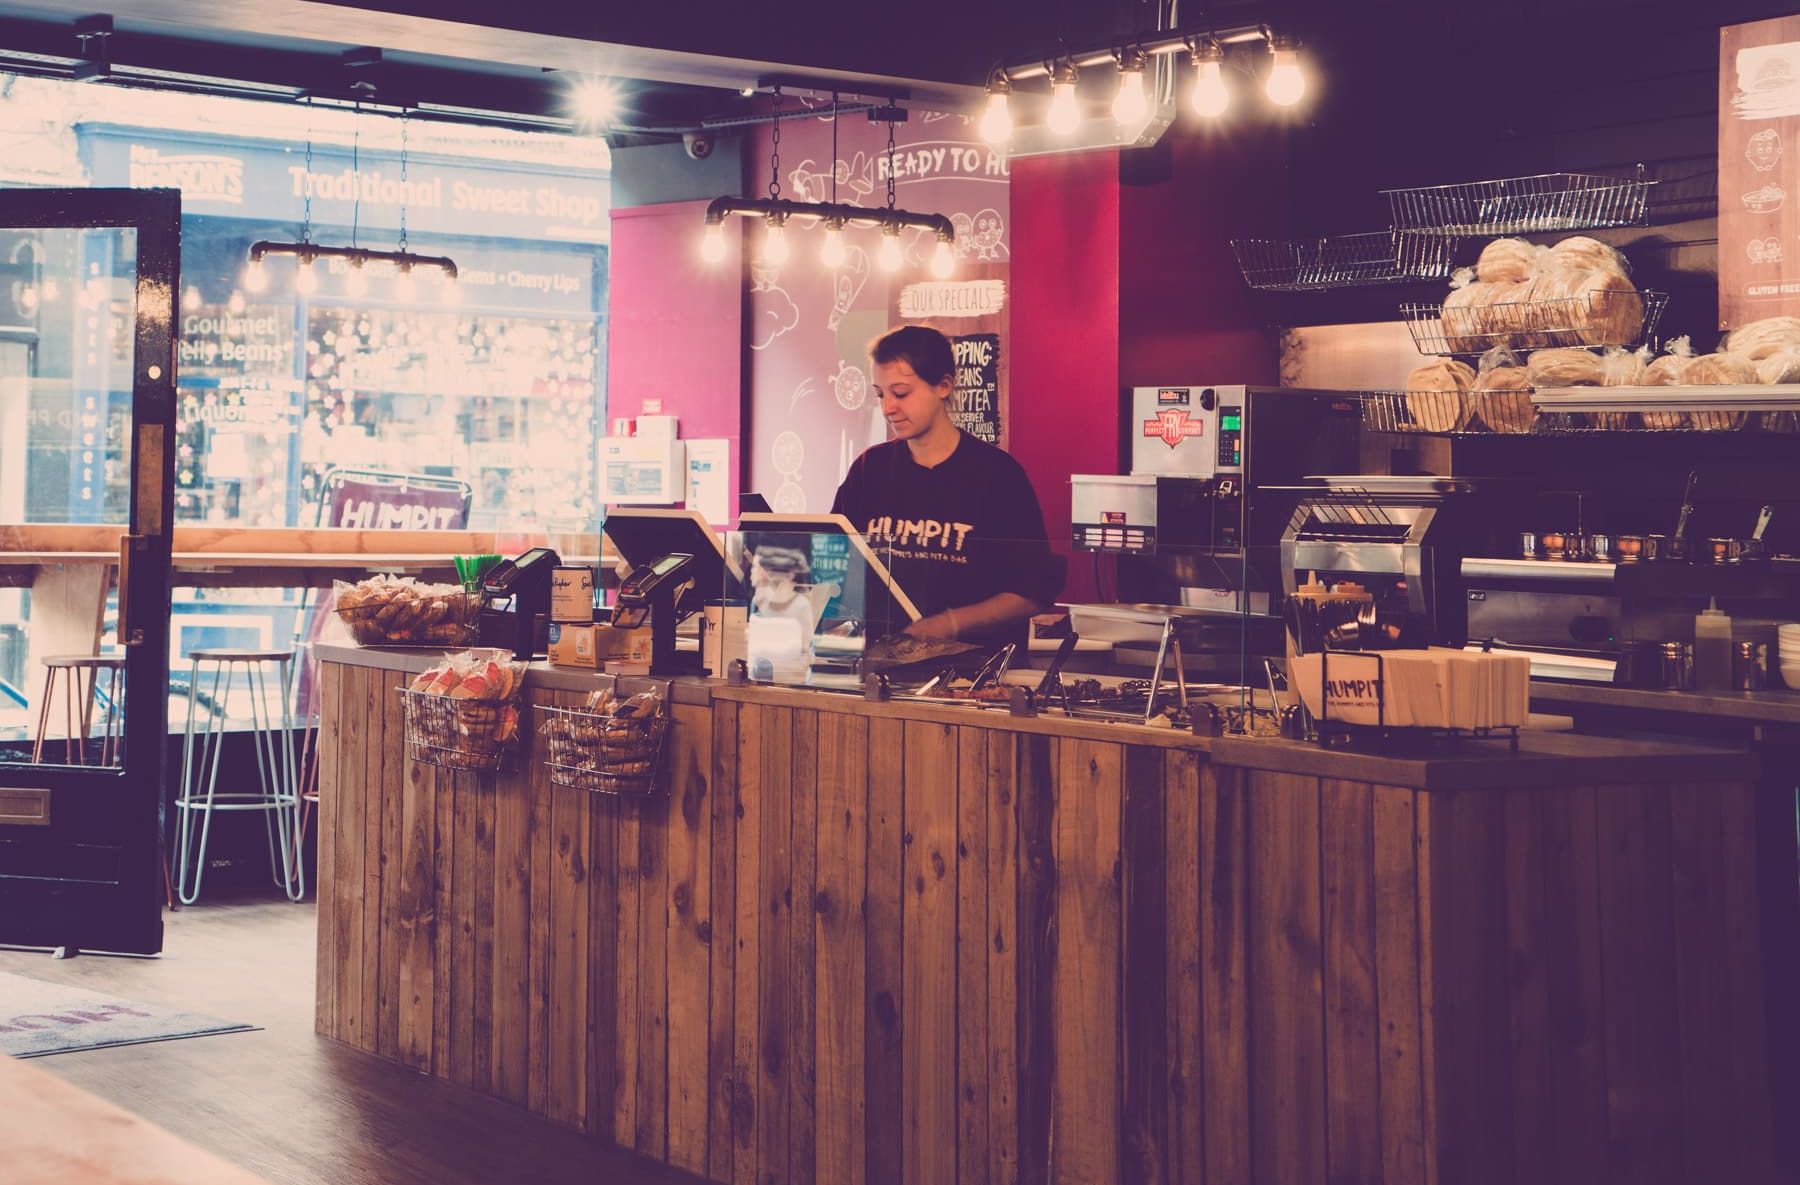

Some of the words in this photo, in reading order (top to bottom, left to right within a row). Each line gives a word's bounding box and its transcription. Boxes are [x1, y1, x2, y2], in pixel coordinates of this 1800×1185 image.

[878, 148, 946, 180] READY
[950, 148, 980, 172] TO
[288, 165, 441, 208] Traditional
[452, 180, 532, 215] Sweet
[535, 187, 599, 223] Shop
[507, 270, 552, 293] Cherry
[553, 274, 582, 294] Lips
[912, 290, 932, 312] OUR
[937, 287, 992, 310] SPECIALS
[177, 340, 217, 365] elly
[221, 341, 283, 362] Beans
[951, 341, 992, 366] PPING:
[948, 388, 991, 413] MPTEA
[1164, 413, 1180, 438] FRY
[340, 498, 458, 529] HUMPIT
[866, 516, 974, 551] HUMPIT
